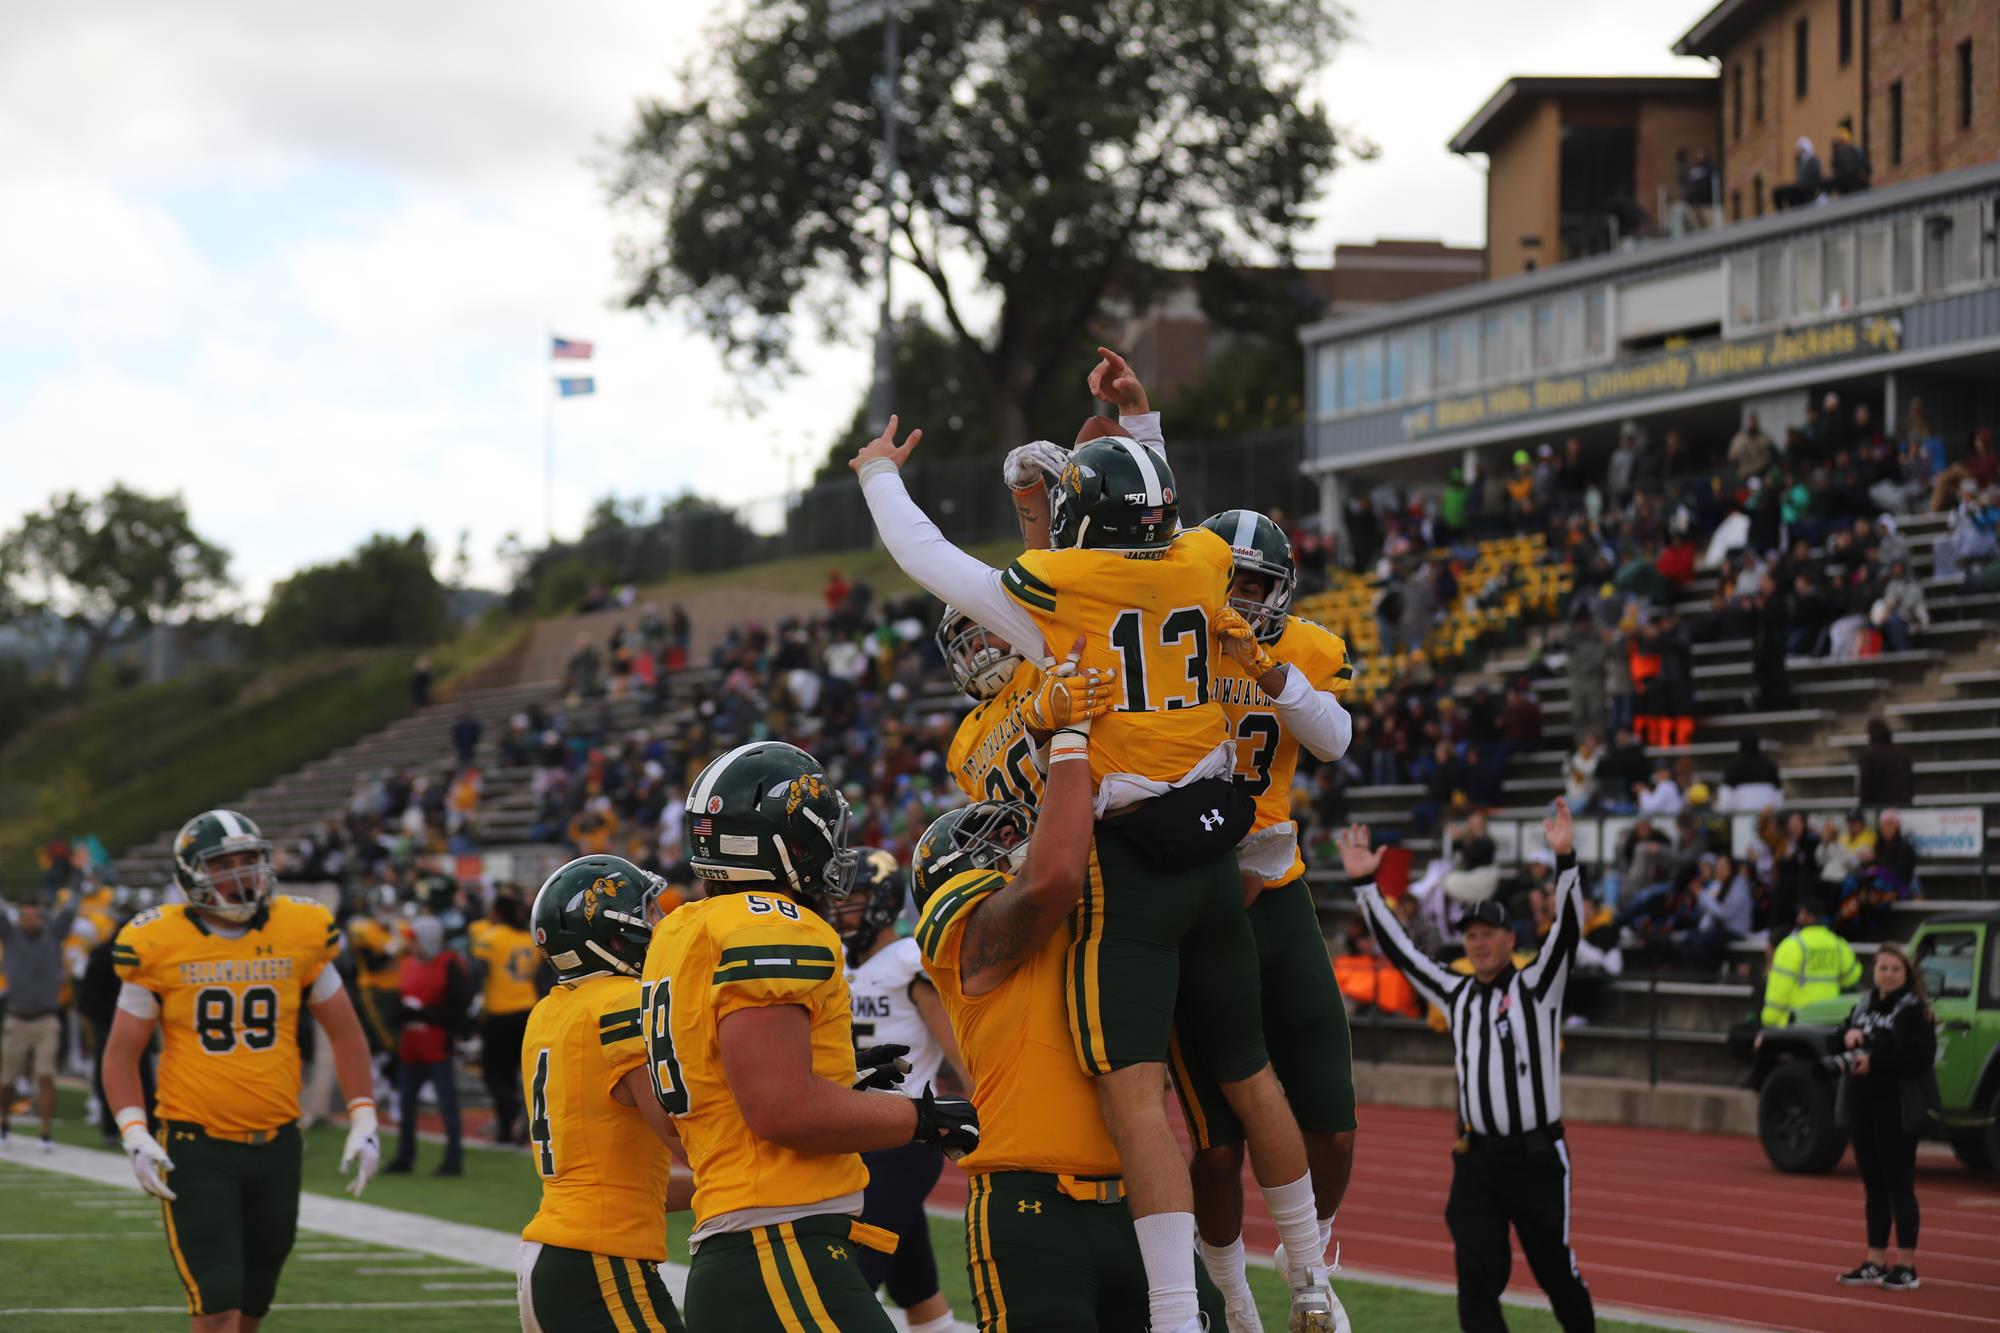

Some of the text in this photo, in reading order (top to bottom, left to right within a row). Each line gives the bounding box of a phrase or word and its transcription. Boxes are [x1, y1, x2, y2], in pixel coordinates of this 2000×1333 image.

[1693, 341, 1765, 376] Yellow
[1769, 323, 1857, 366] Jackets
[1124, 493, 1146, 505] 150
[1143, 532, 1155, 542] 13
[1230, 546, 1254, 557] Riddell
[1109, 605, 1209, 713] 13
[700, 847, 710, 857] 58
[746, 895, 800, 920] 58
[180, 959, 292, 984] YELLOWJACKETS
[196, 984, 279, 1054] 89
[530, 1048, 557, 1178] 4
